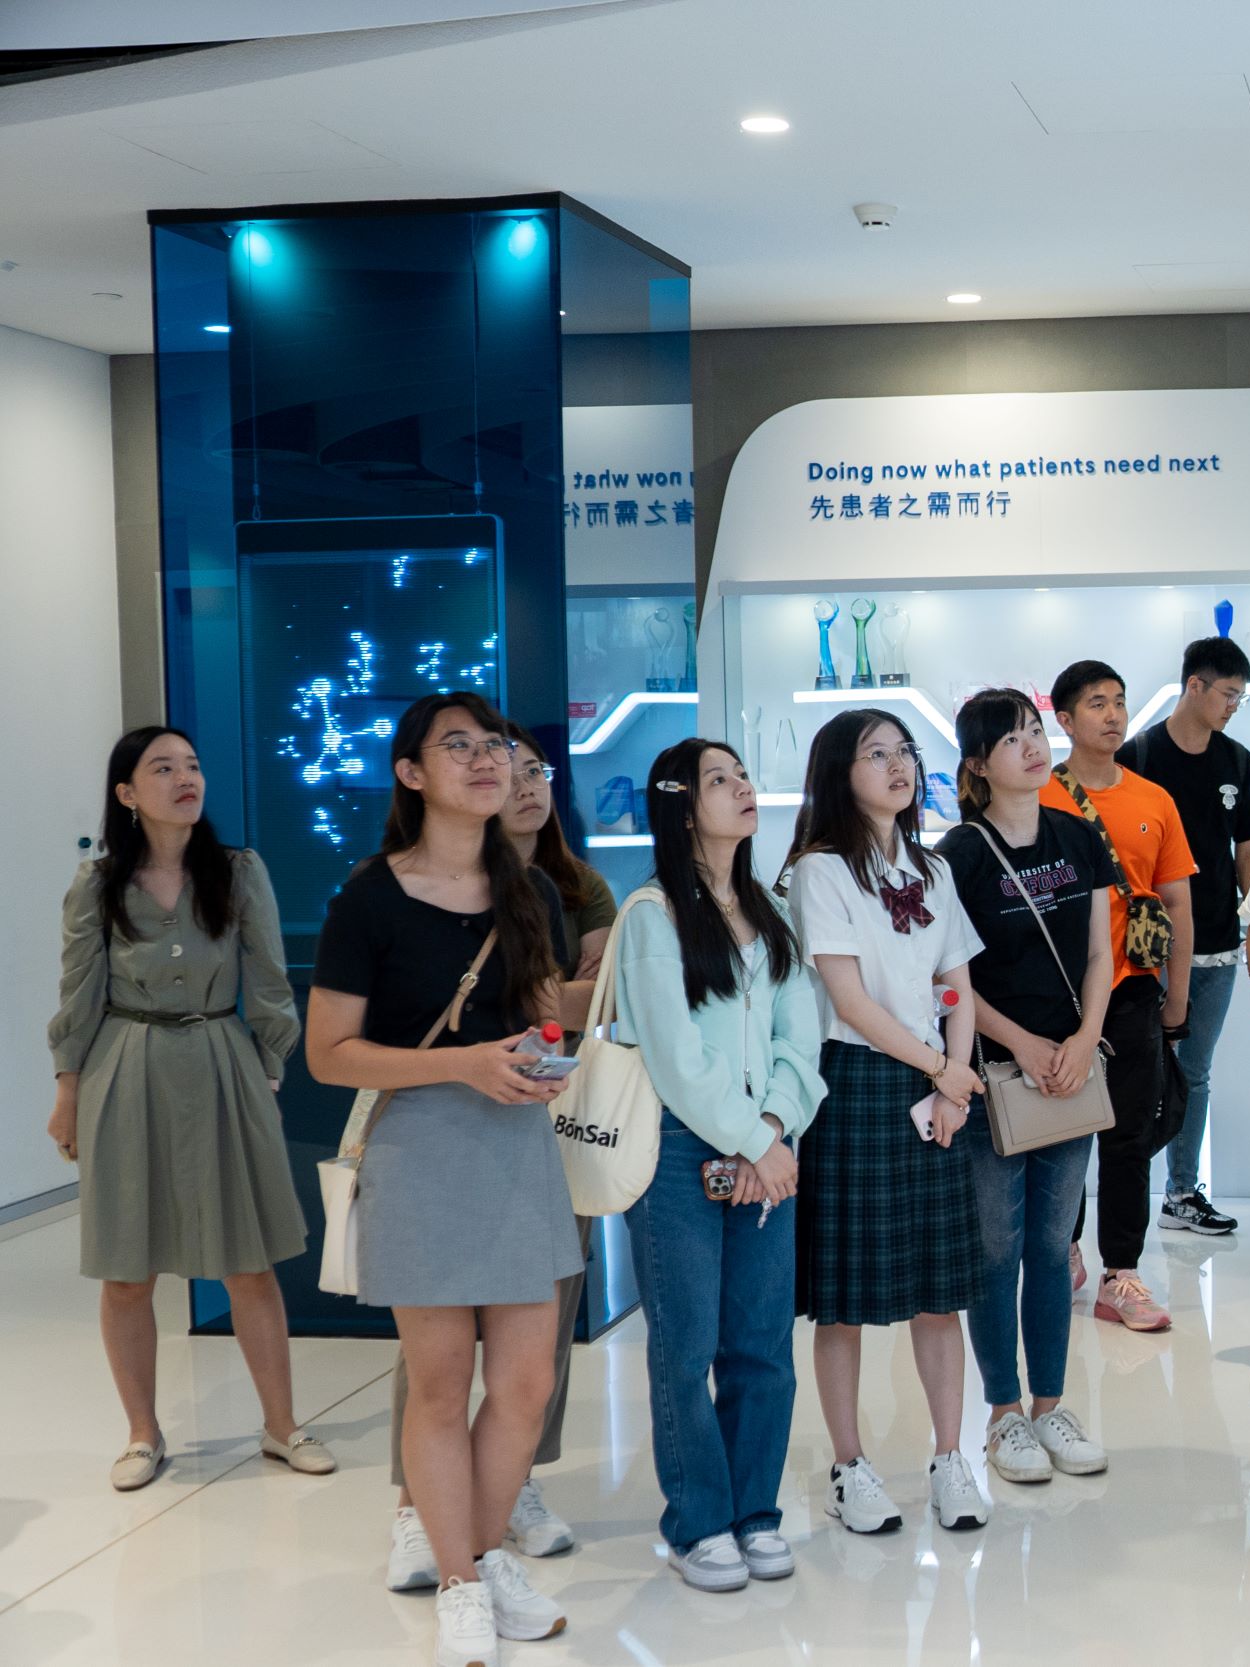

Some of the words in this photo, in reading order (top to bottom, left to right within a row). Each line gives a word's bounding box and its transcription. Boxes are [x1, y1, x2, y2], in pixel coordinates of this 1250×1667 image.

[807, 461, 874, 484] Doing
[881, 463, 927, 481] now
[936, 459, 991, 480] what
[1000, 456, 1096, 481] patients
[1104, 454, 1161, 474] need
[1168, 453, 1221, 473] next
[809, 490, 1012, 521] 先患者之需而行
[1001, 864, 1051, 880] UVERSITY
[1054, 858, 1066, 869] OF
